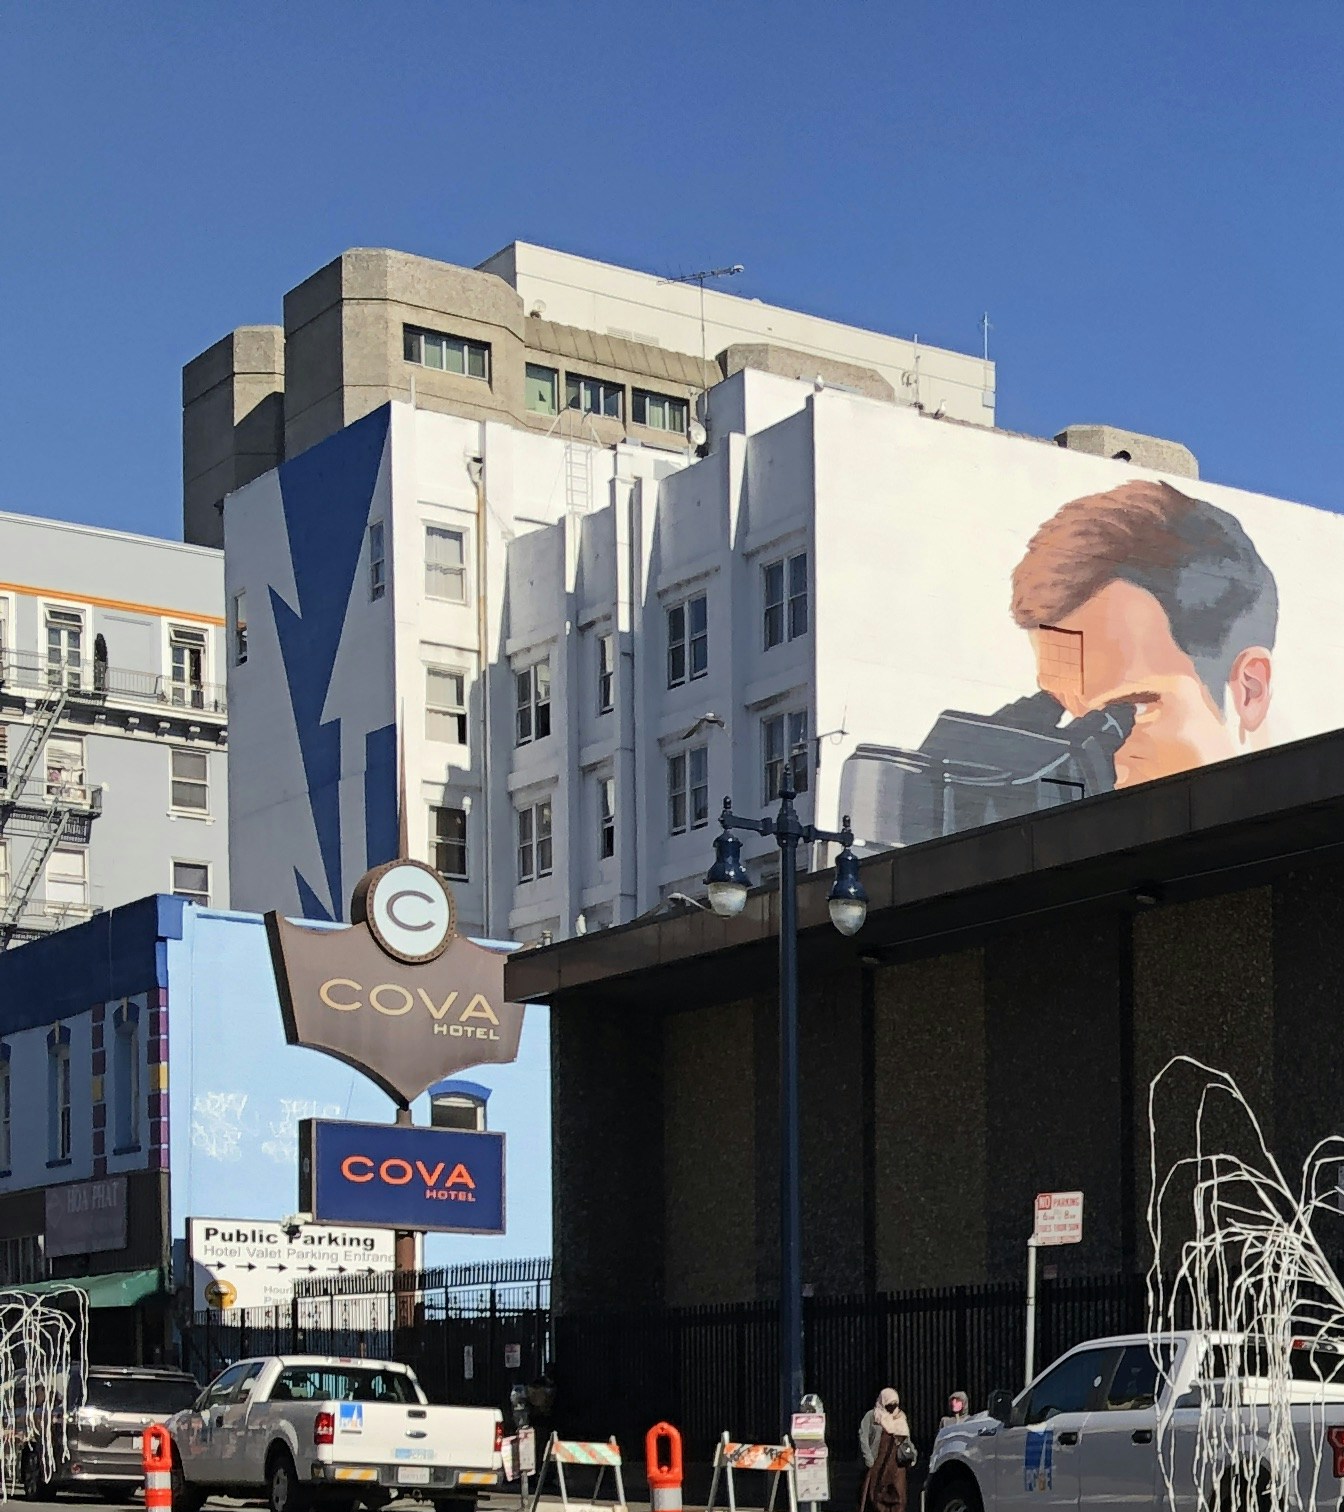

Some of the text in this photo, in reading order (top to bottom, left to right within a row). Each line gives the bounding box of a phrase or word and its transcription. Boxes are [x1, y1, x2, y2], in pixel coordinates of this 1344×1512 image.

[386, 889, 436, 932] C
[319, 977, 500, 1026] COVA
[433, 1023, 500, 1041] HOTEL
[340, 1155, 476, 1189] COVA
[425, 1189, 476, 1202] HOTEL
[204, 1227, 376, 1251] Public Parking
[204, 1245, 395, 1264] Hotel Valet Parking Entranc
[263, 1285, 293, 1295] Hourl
